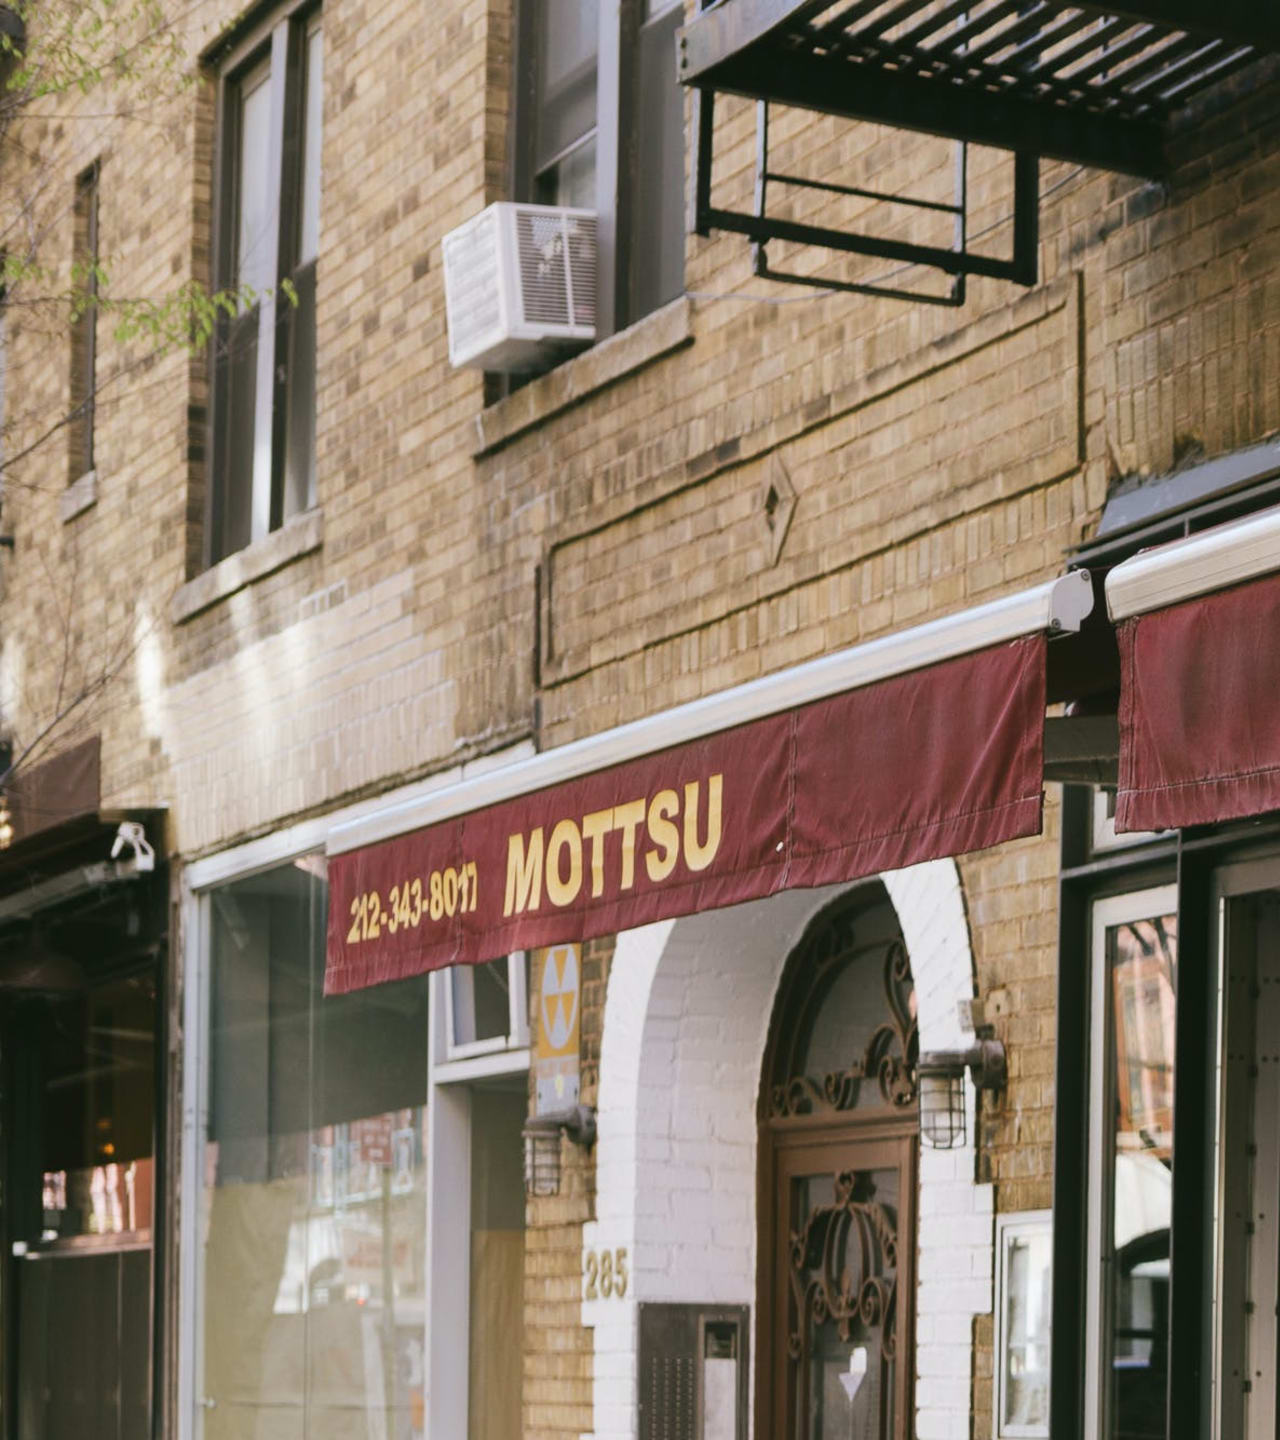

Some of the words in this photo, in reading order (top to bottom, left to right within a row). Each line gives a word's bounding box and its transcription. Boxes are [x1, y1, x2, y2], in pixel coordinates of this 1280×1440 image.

[346, 861, 478, 944] 212-343-8017
[502, 774, 724, 918] MOTTSU
[585, 1247, 628, 1301] 285
